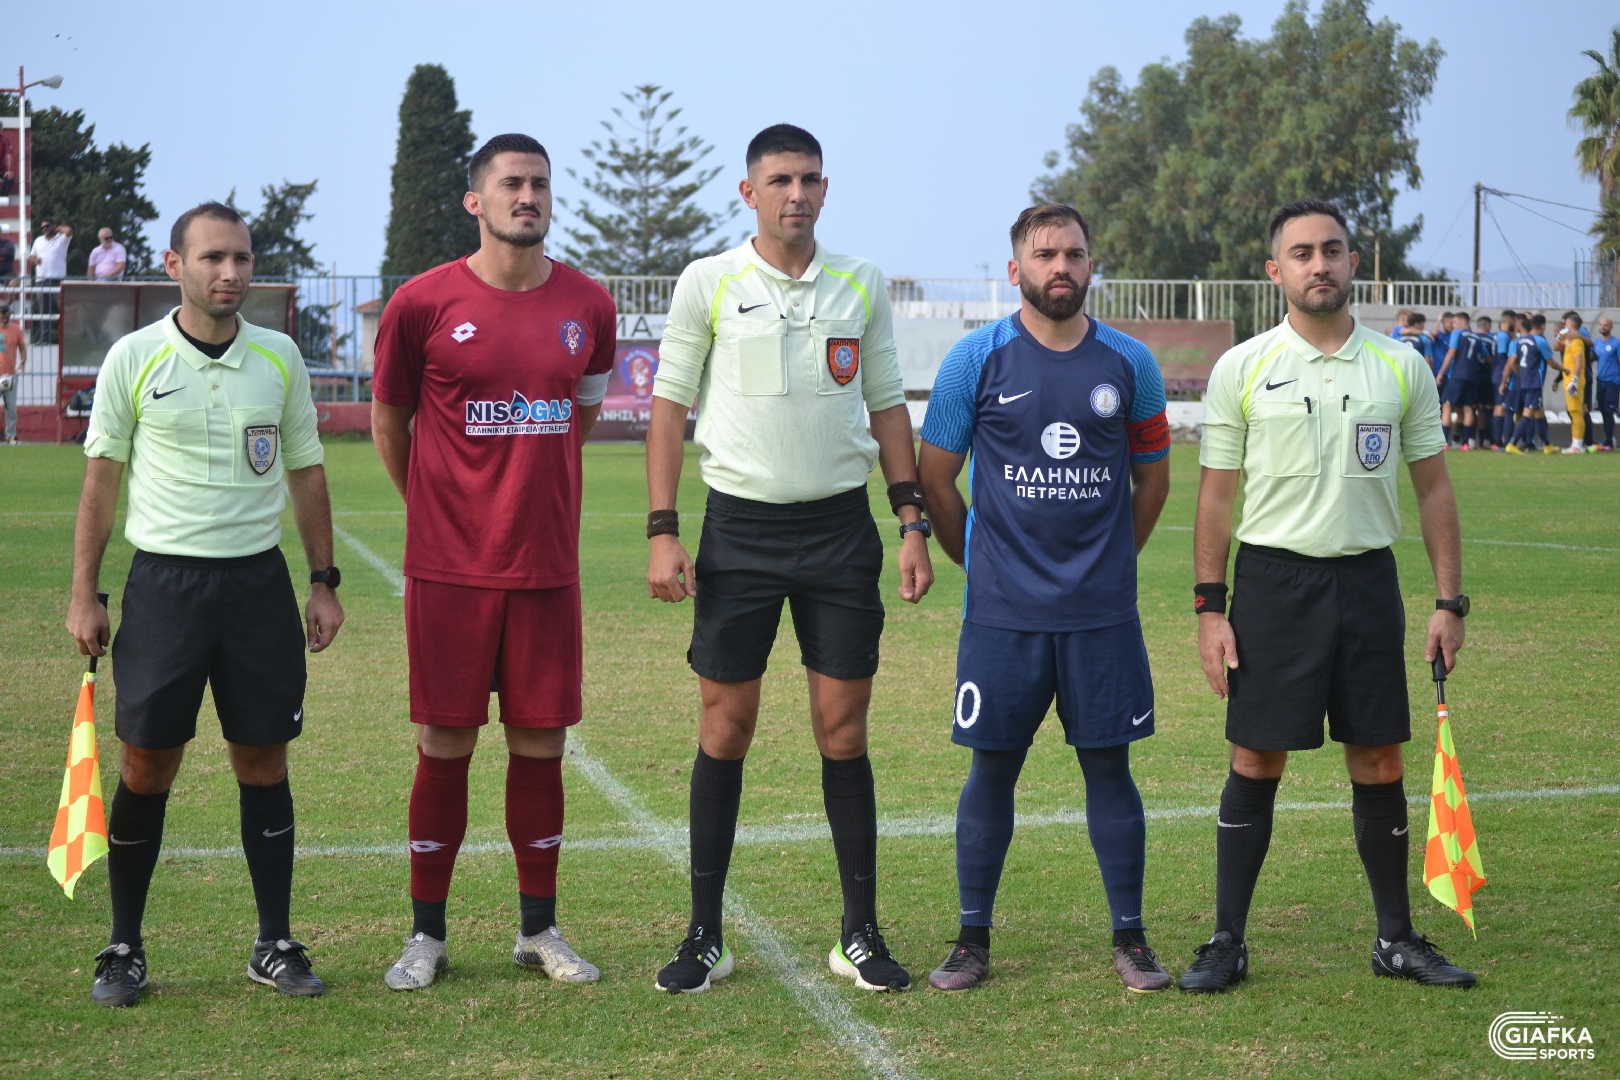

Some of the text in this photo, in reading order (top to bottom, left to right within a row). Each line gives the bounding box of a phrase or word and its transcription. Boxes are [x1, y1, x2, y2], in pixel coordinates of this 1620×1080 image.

[1467, 337, 1476, 359] 7
[1520, 344, 1528, 368] 2
[467, 426, 505, 434] ΕΛΛΗΝΙΚΗ
[254, 460, 269, 468] ΕΠΟ
[1365, 453, 1380, 461] ΕΠΟ
[1004, 464, 1111, 484] ΕΛΛΗΝΙΚΑ
[1016, 485, 1101, 500] ΠΕΤΡΕΛΑΙΑ
[952, 677, 982, 729] 0
